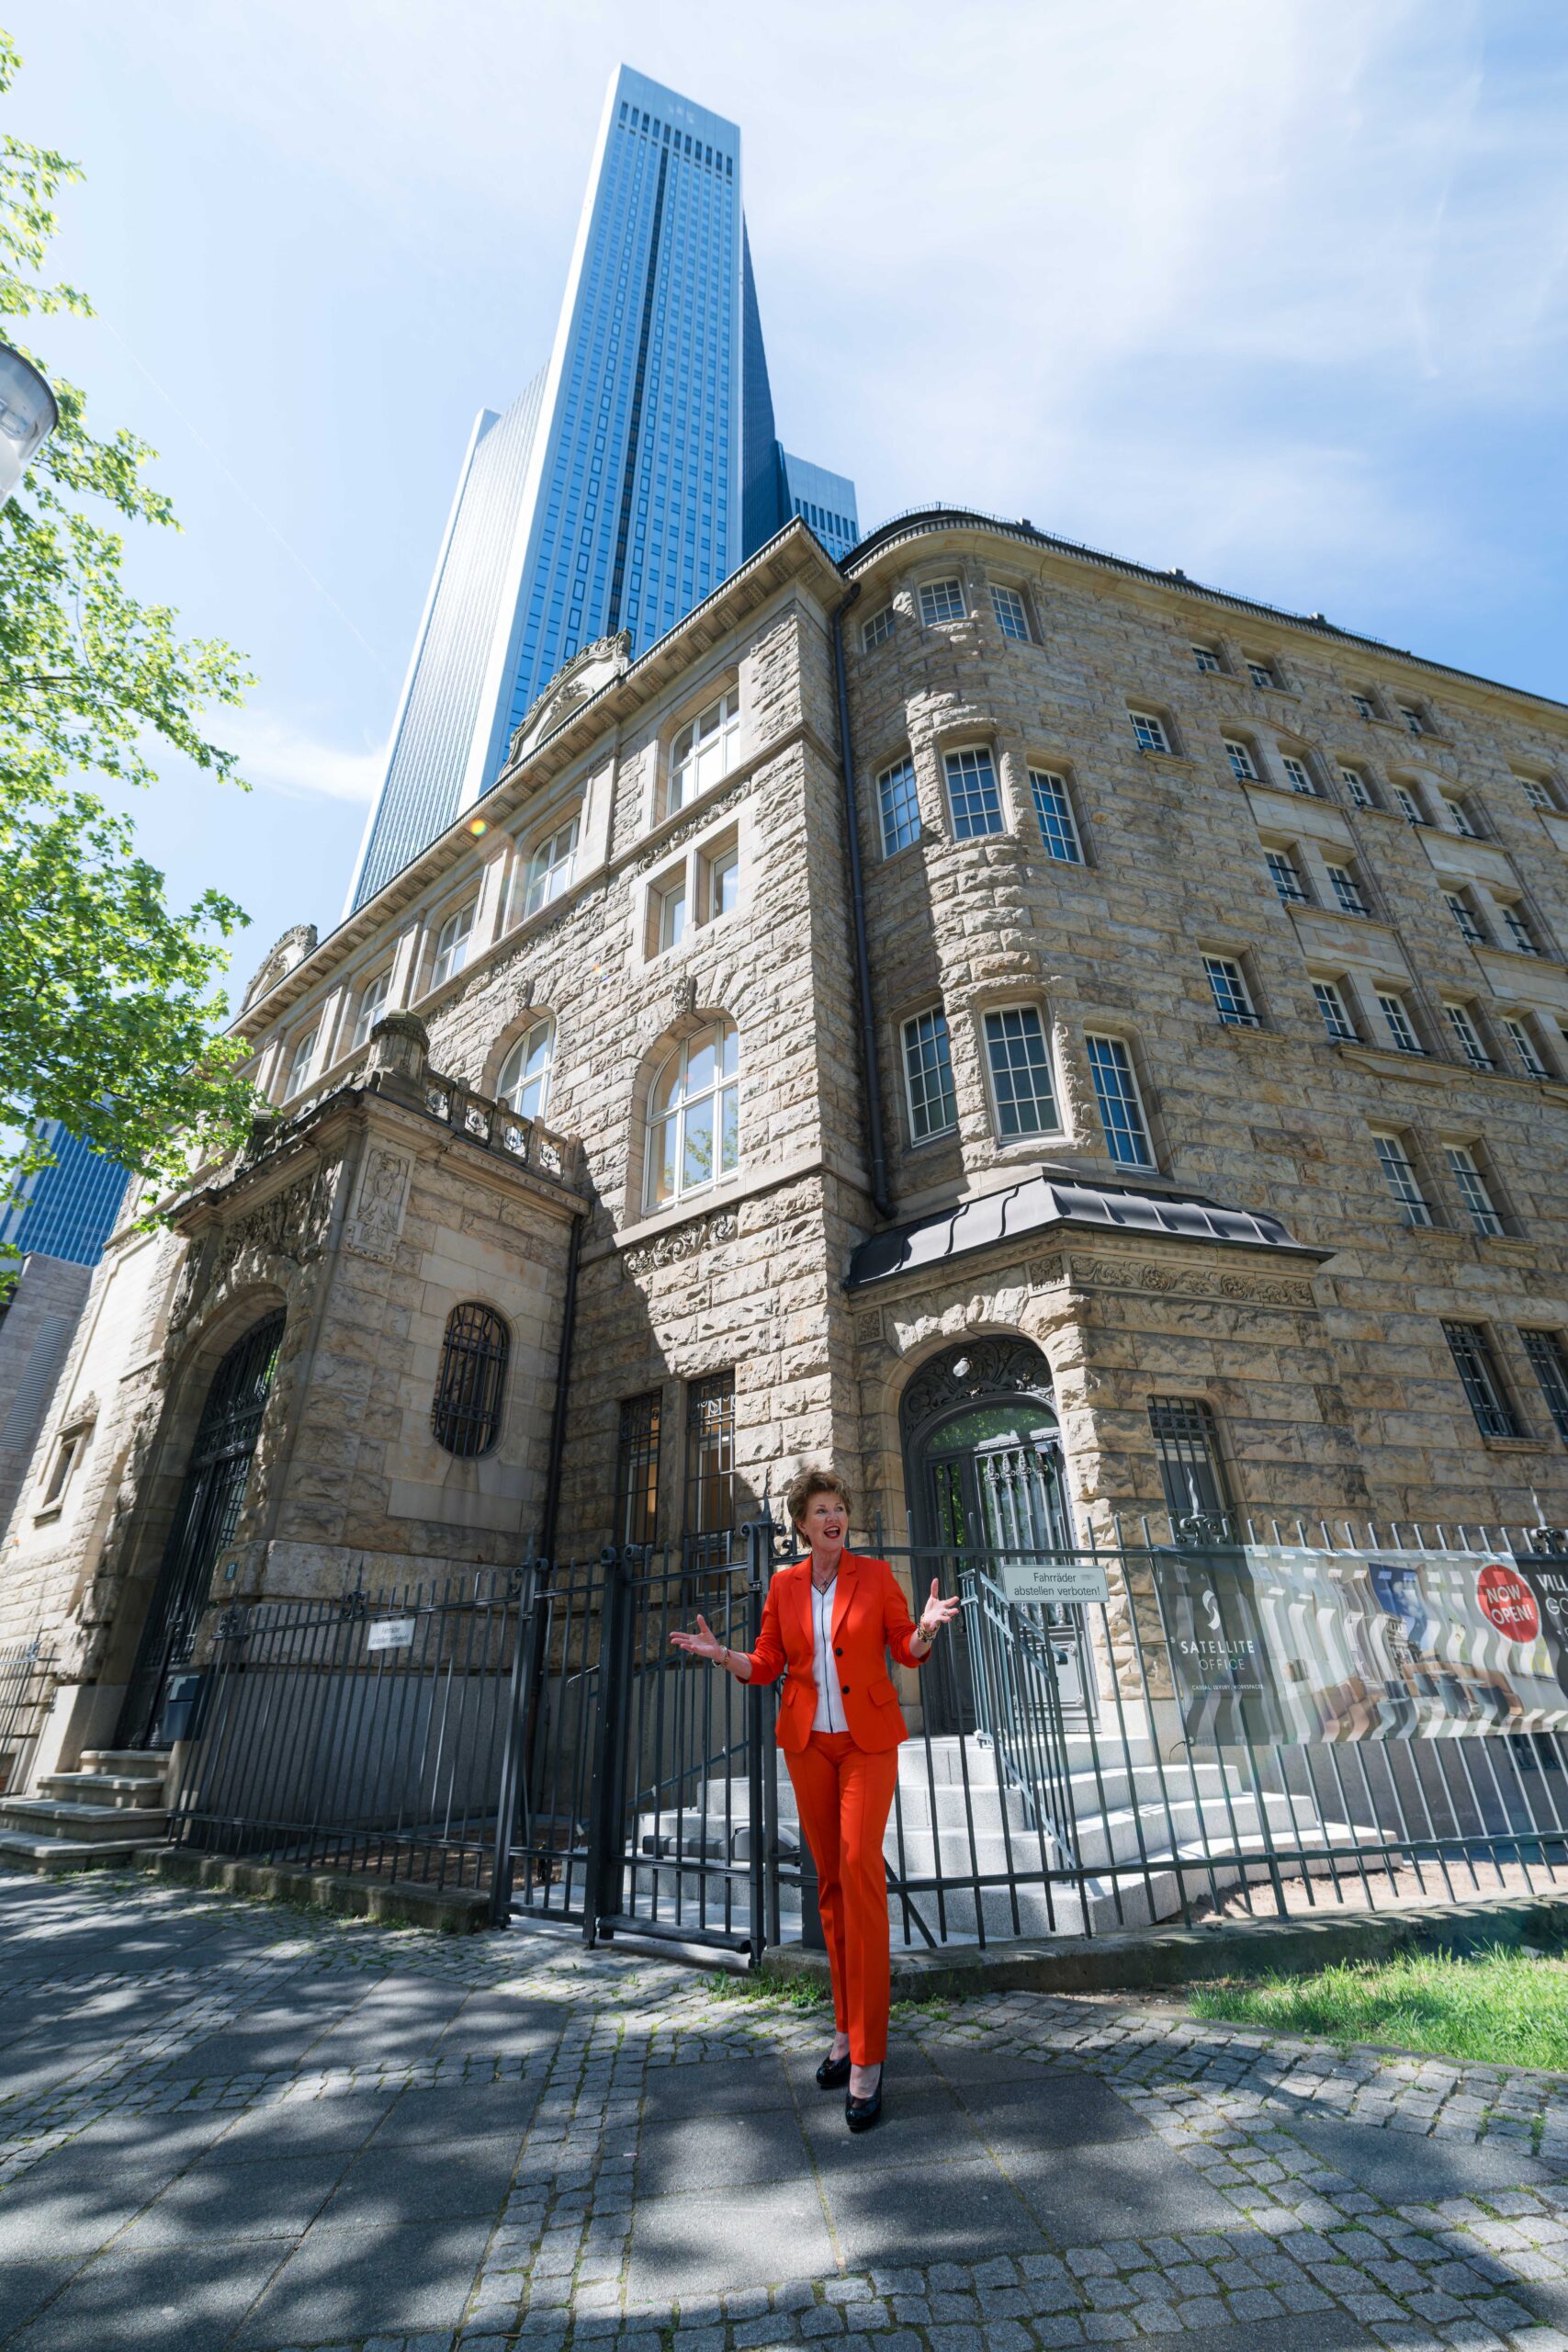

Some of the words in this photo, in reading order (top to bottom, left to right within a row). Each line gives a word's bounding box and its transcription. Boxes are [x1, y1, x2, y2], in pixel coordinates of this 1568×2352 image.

[1033, 1572, 1077, 1583] Fahrräder
[1014, 1586, 1055, 1596] abstellen
[1057, 1586, 1100, 1596] verboten!
[1485, 1584, 1521, 1604] NOW
[1491, 1603, 1535, 1625] OPEN!
[1180, 1640, 1255, 1654] SATELLITE
[1200, 1658, 1246, 1670] OFFICE
